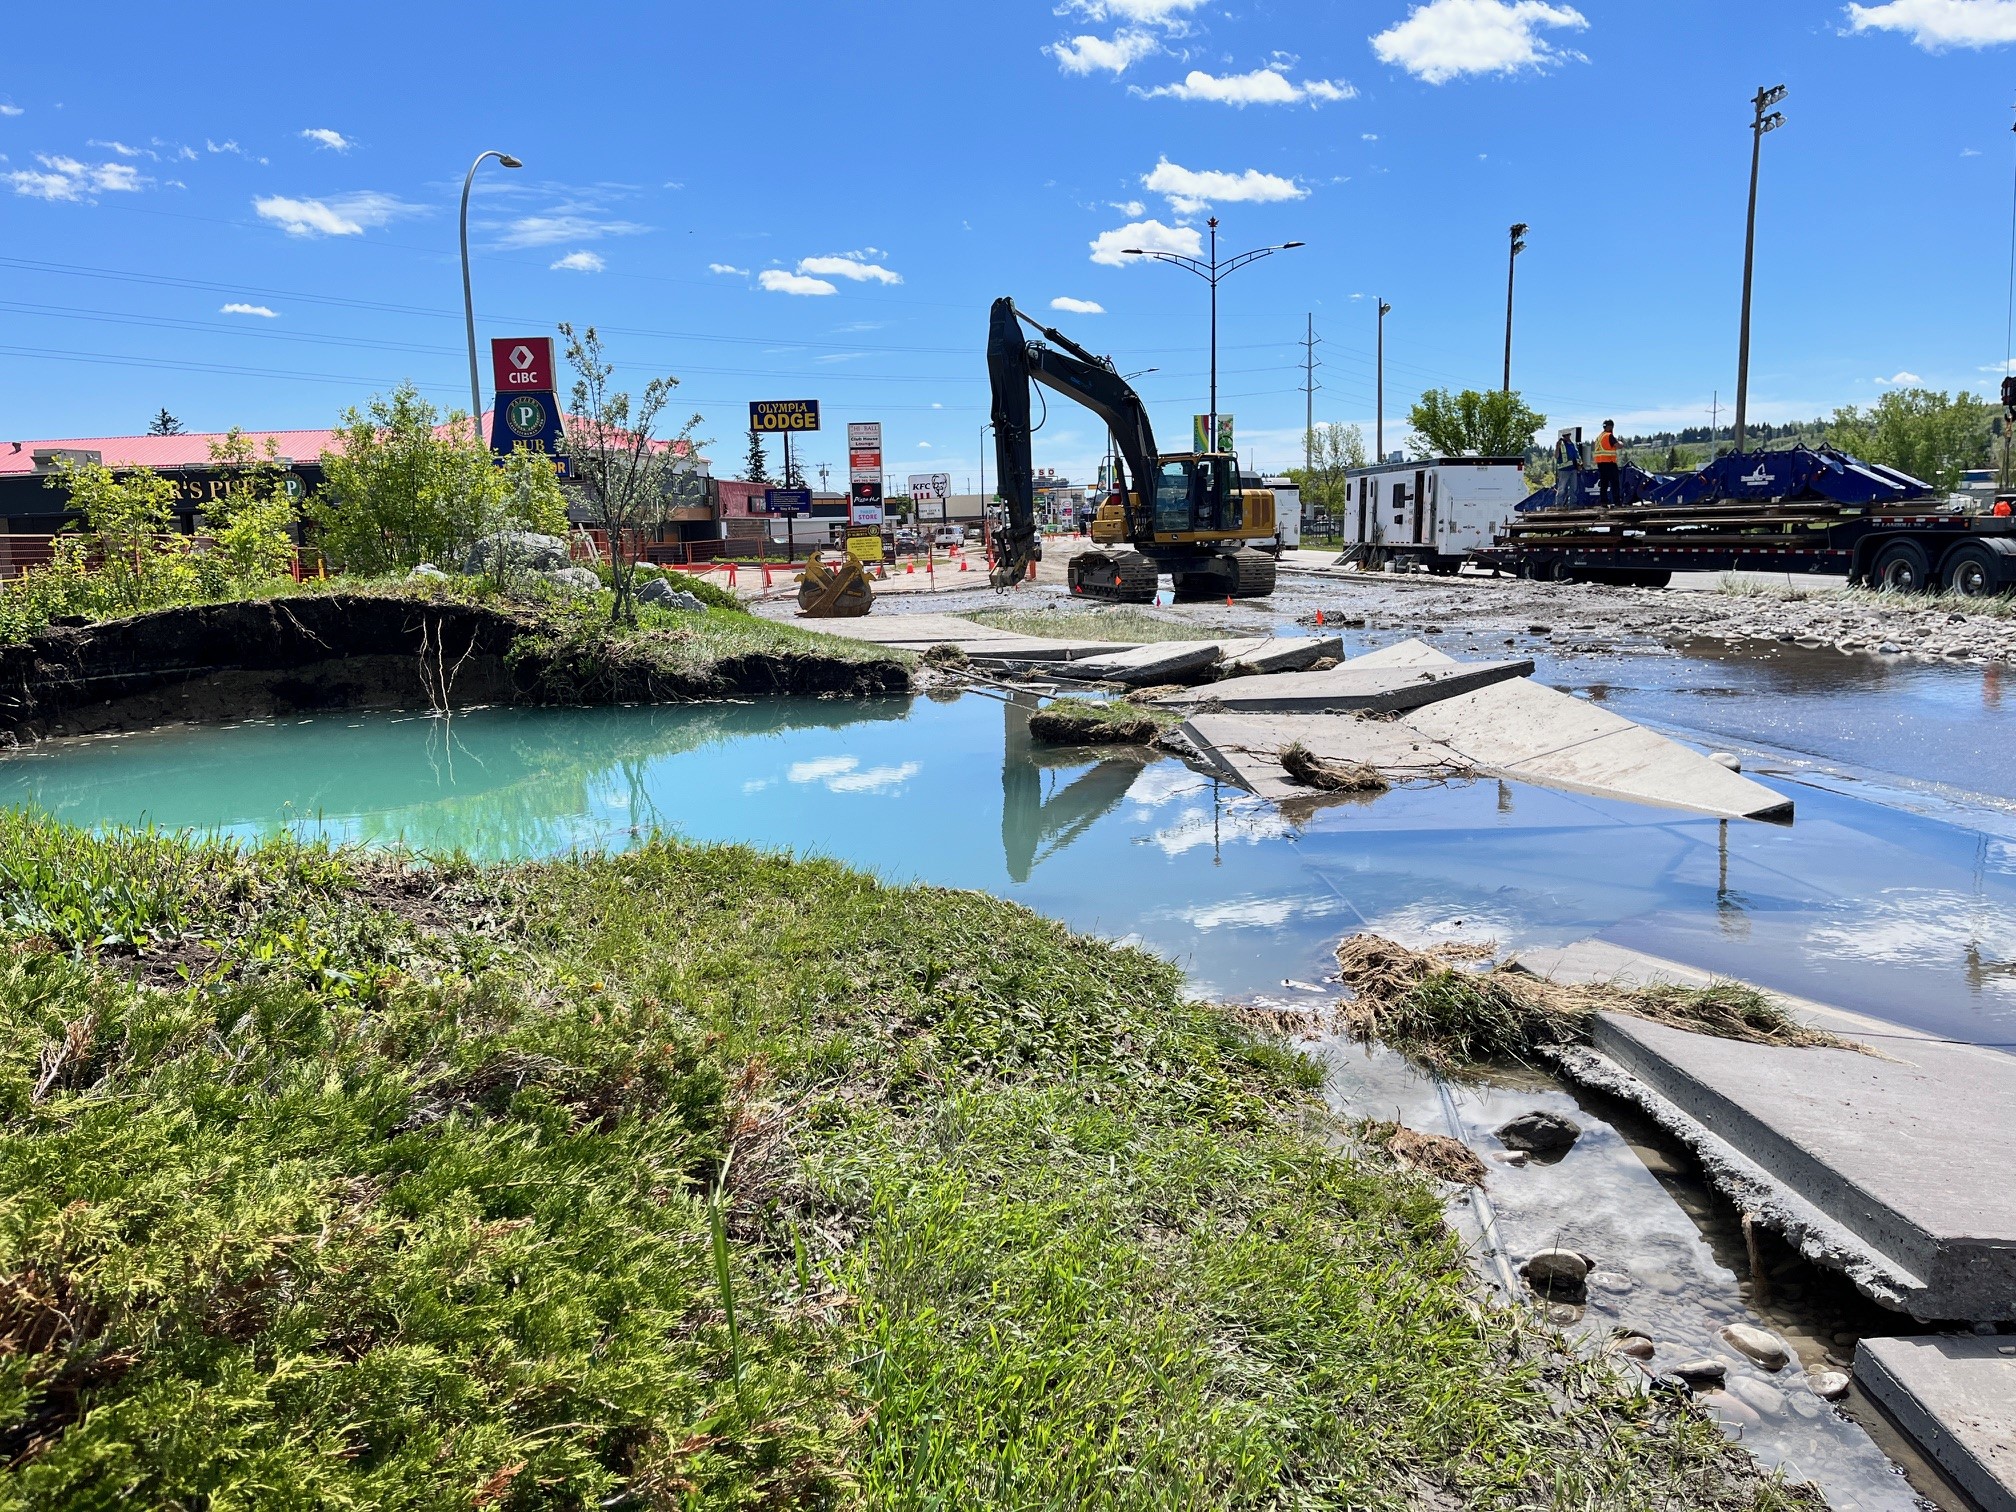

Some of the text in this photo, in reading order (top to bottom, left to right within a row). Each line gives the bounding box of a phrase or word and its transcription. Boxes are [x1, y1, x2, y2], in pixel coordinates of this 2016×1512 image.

[509, 371, 538, 384] CIBC
[758, 402, 808, 414] OLYMPIA
[519, 406, 533, 426] P
[753, 413, 816, 430] LODGE
[512, 439, 545, 453] PUB
